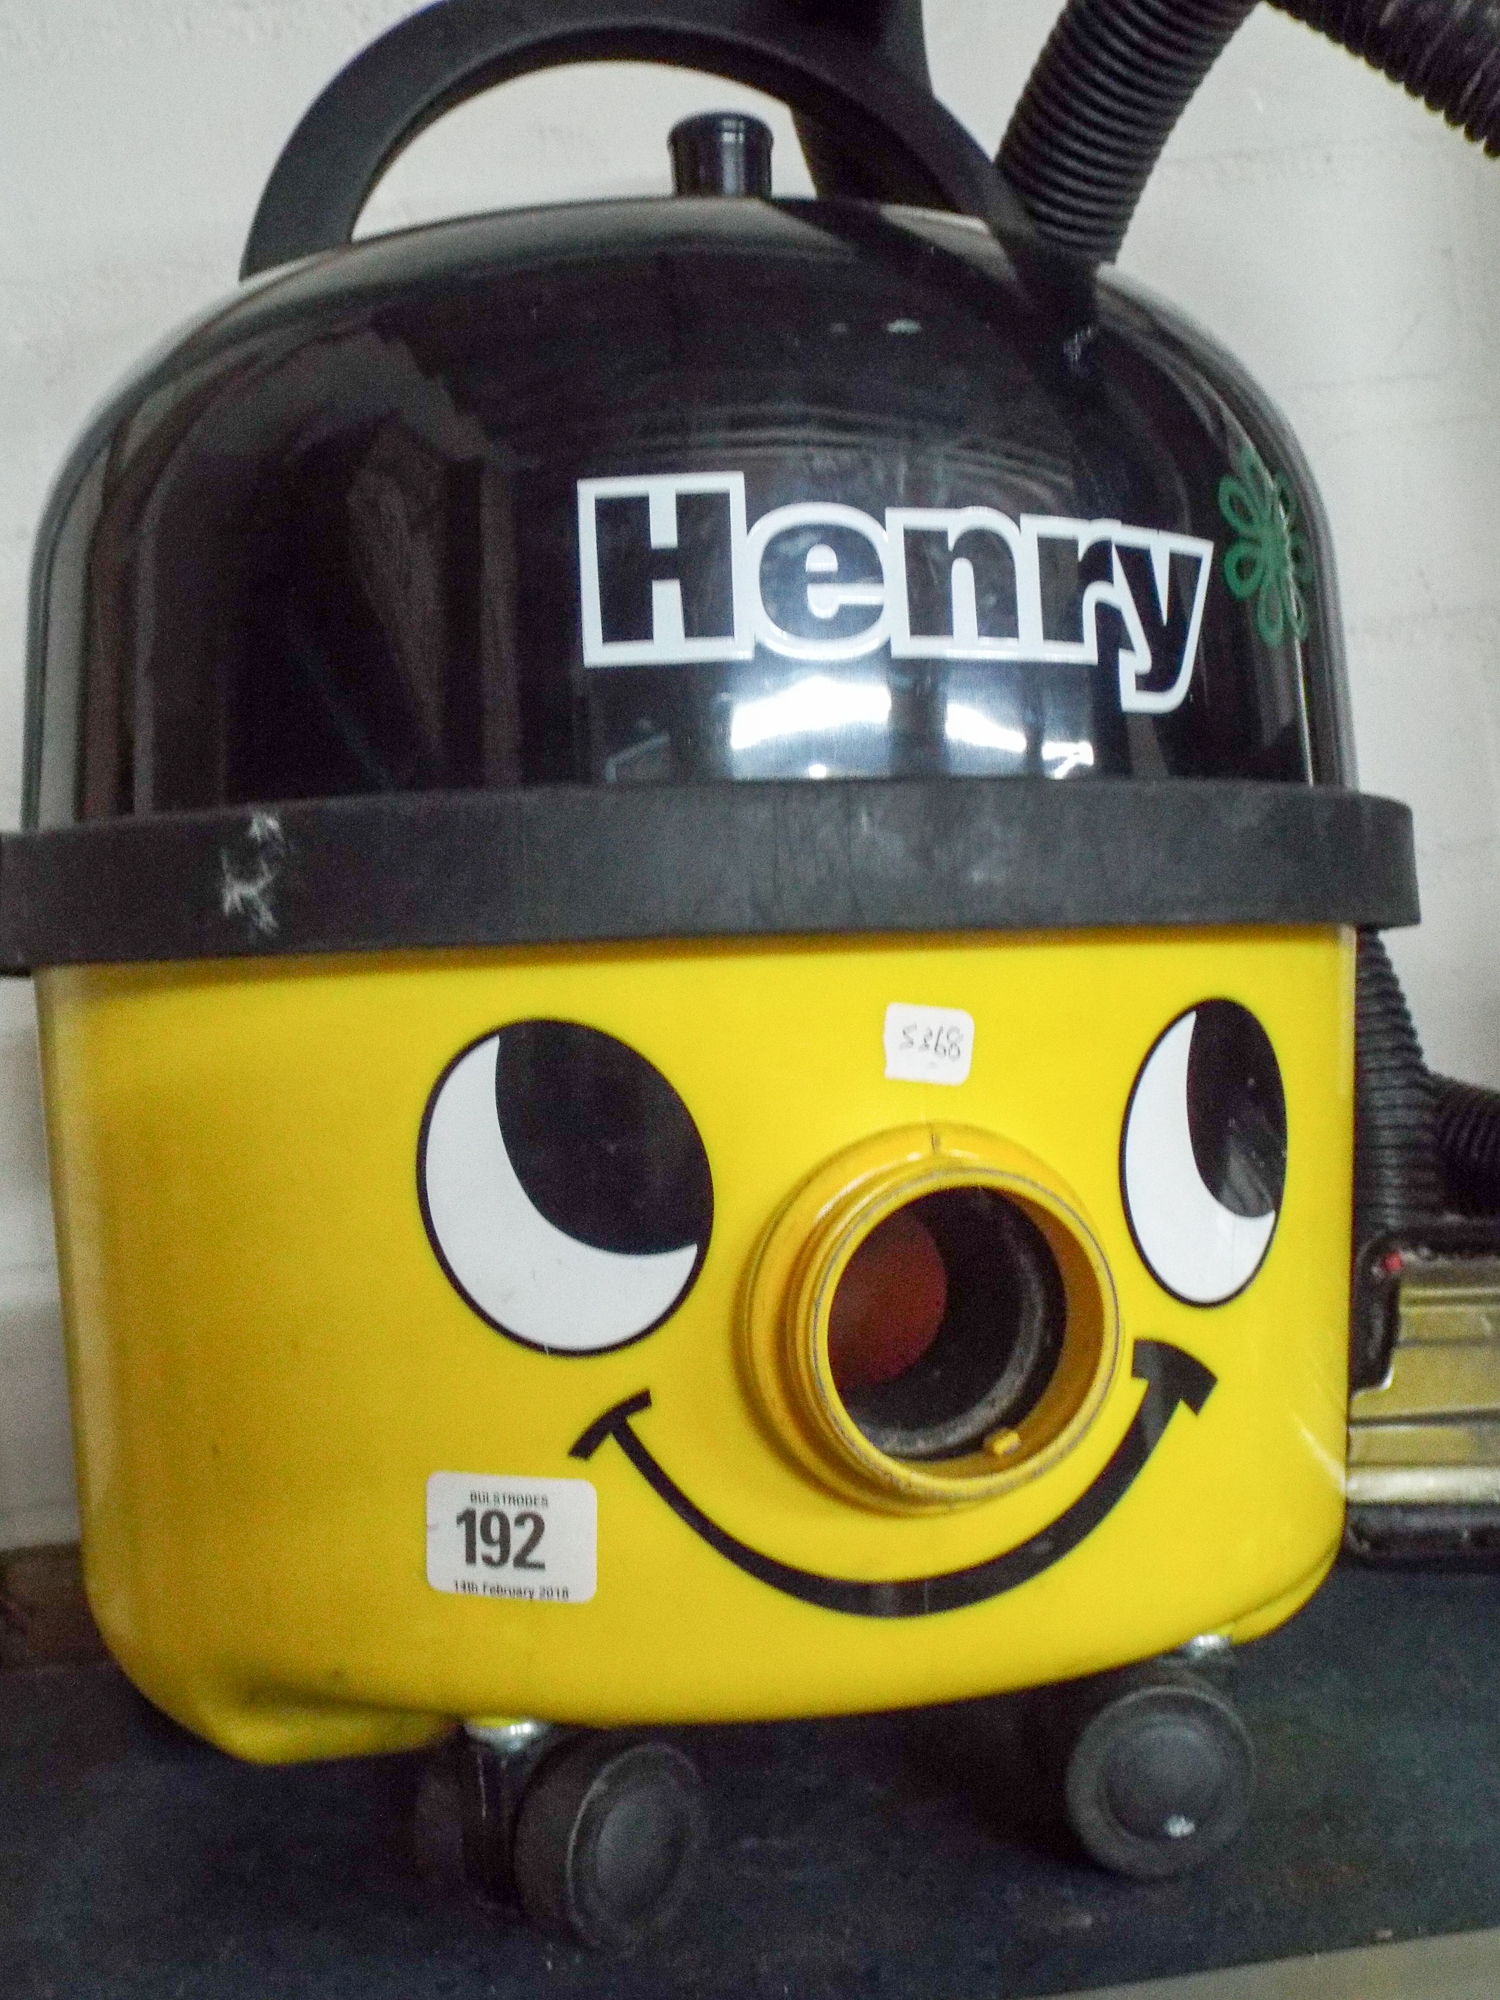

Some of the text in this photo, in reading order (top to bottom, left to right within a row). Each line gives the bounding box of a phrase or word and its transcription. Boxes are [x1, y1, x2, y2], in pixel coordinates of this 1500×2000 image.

[577, 471, 1213, 713] Henry
[456, 1507, 546, 1570] 192
[454, 1580, 478, 1594] 14th
[482, 1581, 534, 1600] February
